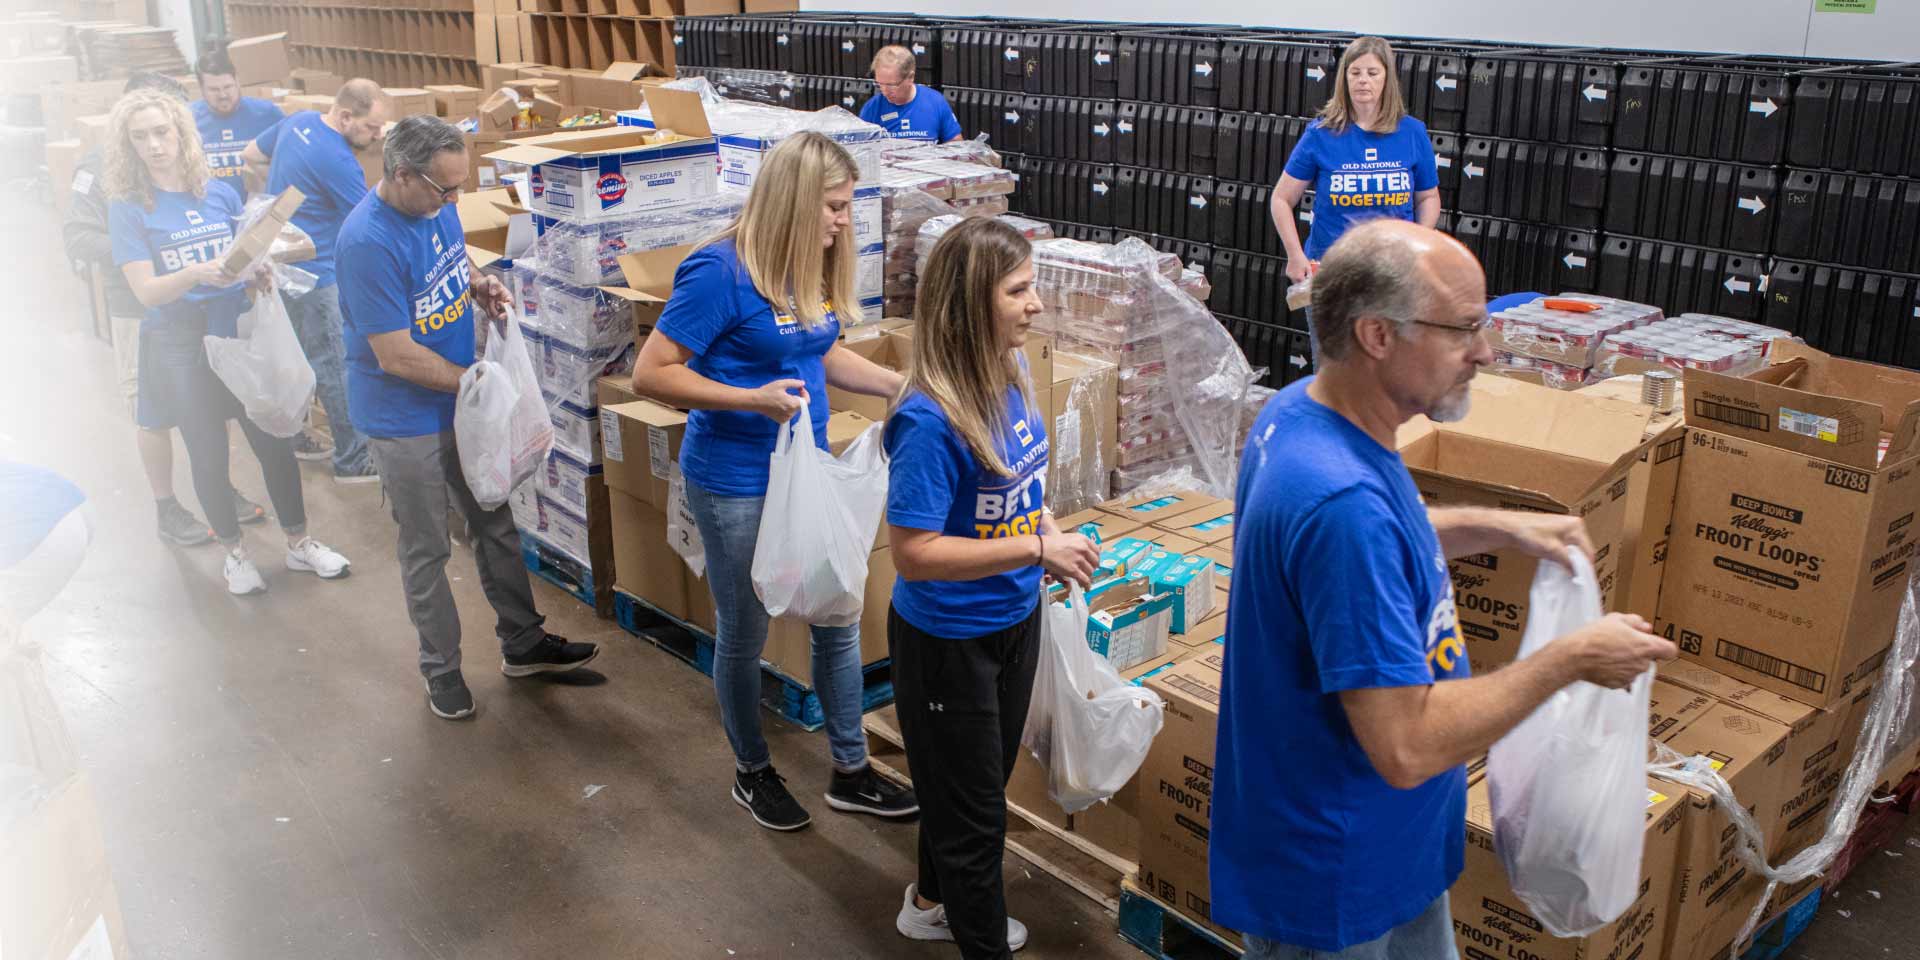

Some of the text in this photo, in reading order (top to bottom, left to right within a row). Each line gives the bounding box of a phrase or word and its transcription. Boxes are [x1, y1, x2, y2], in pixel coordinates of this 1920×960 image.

[206, 153, 243, 168] ETT
[1342, 162, 1360, 170] OLD
[658, 170, 682, 180] APPLES
[1330, 172, 1411, 192] BETTER
[1330, 192, 1410, 207] TOGETHER
[170, 228, 190, 241] OLD
[160, 236, 234, 271] BETTE
[424, 240, 463, 283] OLD NATIONAL
[1702, 391, 1761, 409] Single Stock
[1692, 431, 1717, 450] 96-1
[1826, 466, 1868, 492] 78788
[1737, 496, 1795, 520] DEEP BOWLS
[1730, 513, 1791, 541] Kellogg's
[1695, 522, 1820, 572] FROOT LOOPS
[1793, 569, 1821, 583] cereal
[1455, 590, 1519, 621] LOOPS
[1492, 618, 1520, 632] cereal
[1663, 622, 1700, 654] 4 FS
[1187, 758, 1205, 775] DEEP
[1159, 778, 1202, 814] FROOT
[1159, 878, 1176, 903] FS
[1486, 902, 1537, 929] DEEP BOWLS
[1453, 920, 1504, 951] FROOT
[1483, 914, 1536, 943] Kellogg's
